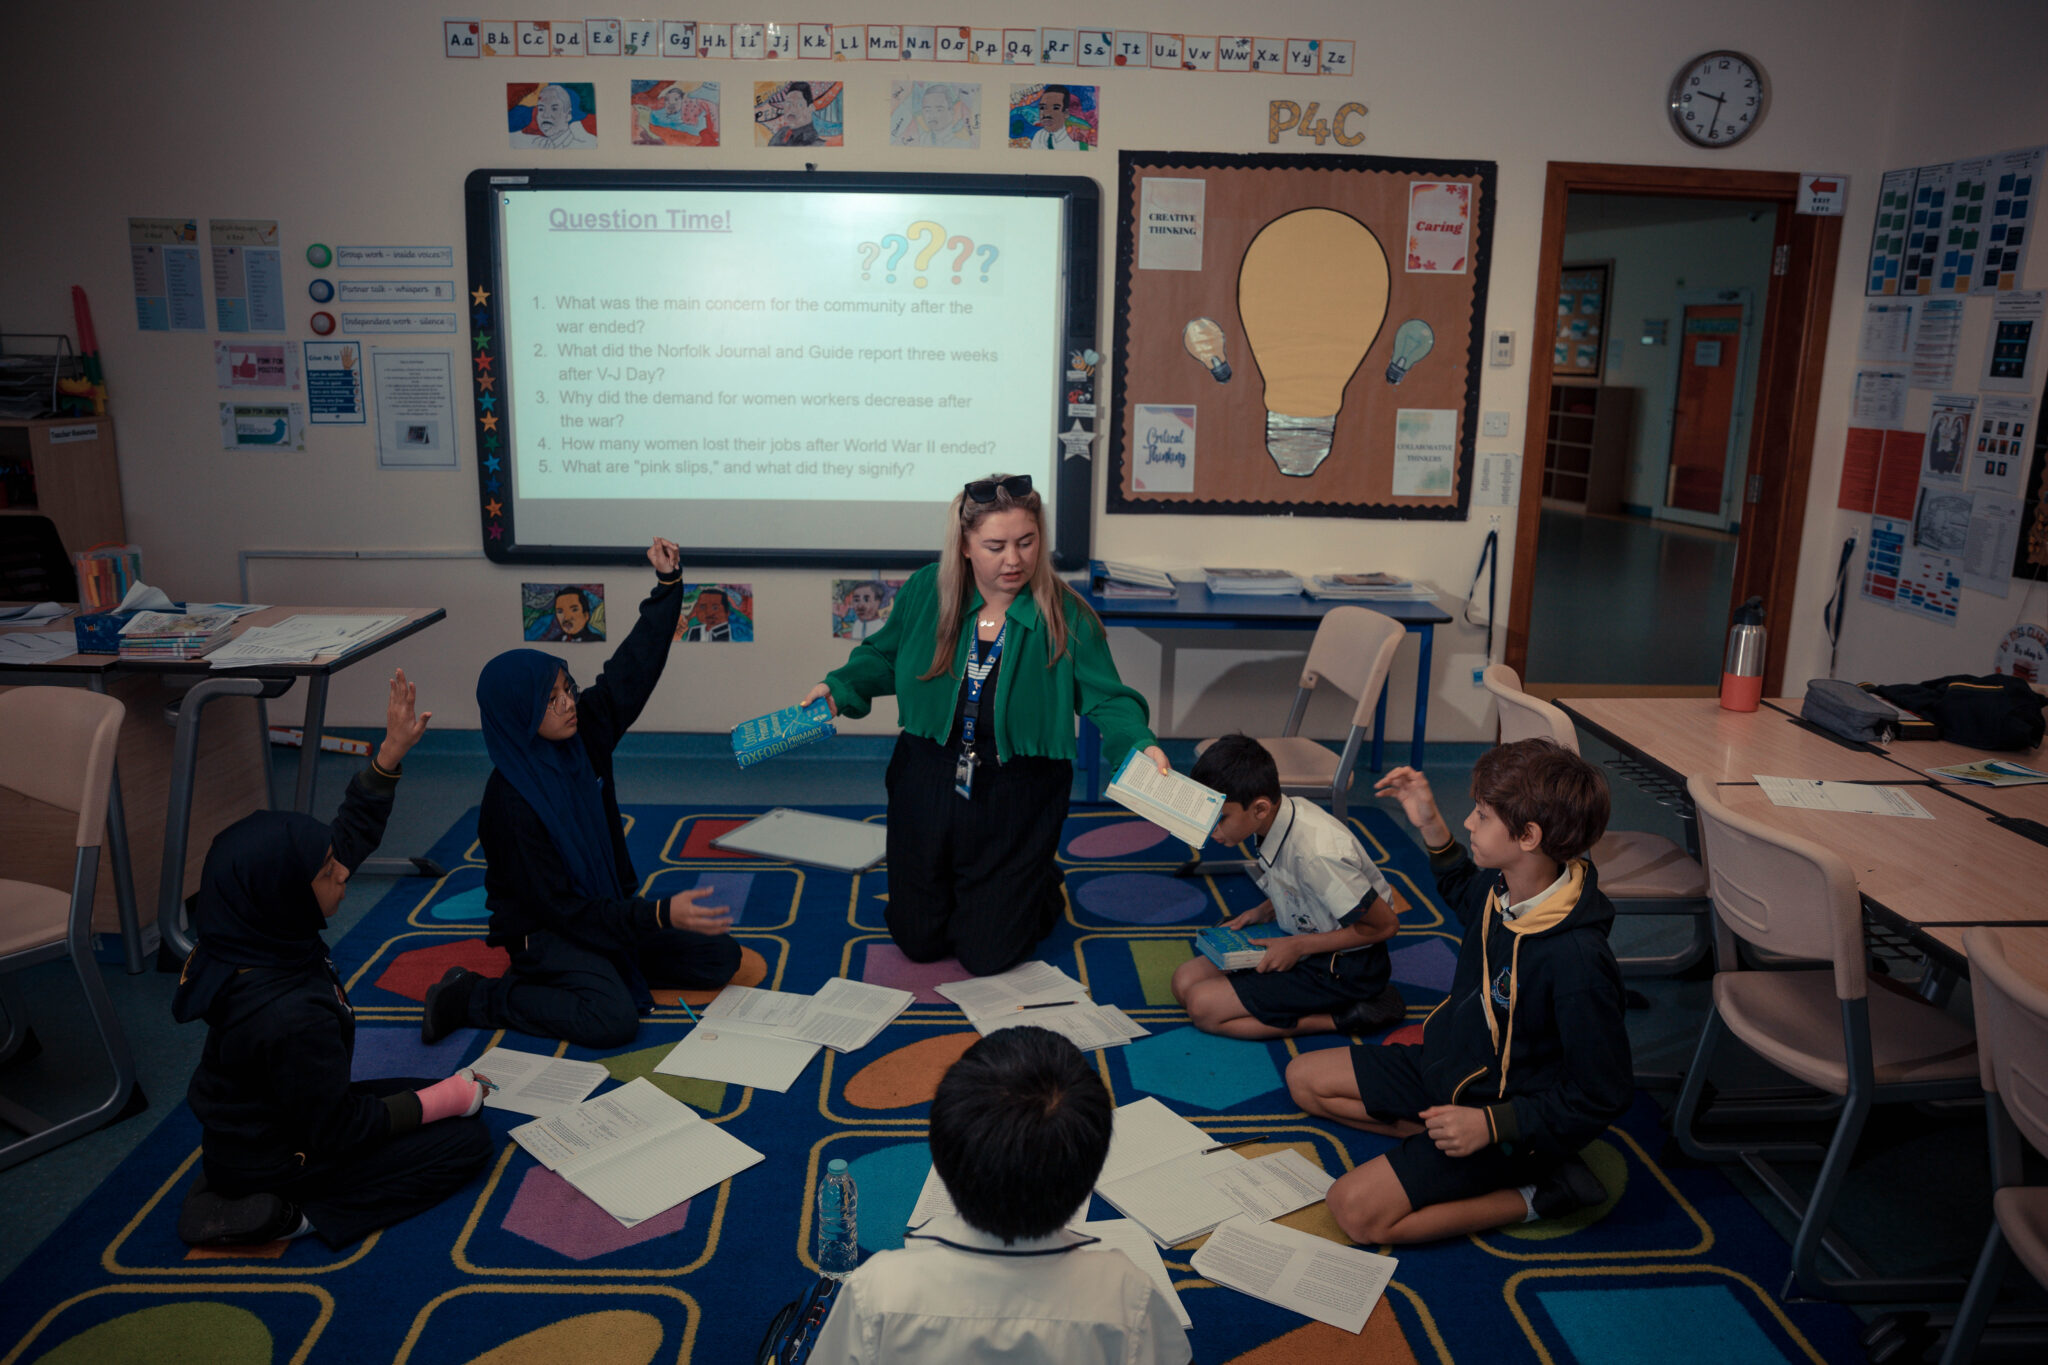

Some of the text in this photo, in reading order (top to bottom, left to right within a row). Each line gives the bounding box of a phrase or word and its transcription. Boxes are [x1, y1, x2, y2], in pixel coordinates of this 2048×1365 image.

[1718, 60, 1730, 70] 12
[1703, 66, 1711, 75] 11
[1690, 76, 1700, 86] 10
[1744, 79, 1753, 88] 2
[1682, 93, 1692, 102] 9
[1746, 96, 1755, 106] 3
[1685, 111, 1695, 121] 8
[1739, 113, 1748, 122] 4
[1268, 99, 1368, 147] P4C
[1696, 124, 1704, 134] 7
[1726, 126, 1735, 135] 5
[549, 208, 732, 230] Question Time!
[1149, 213, 1197, 222] CREATIVE
[1148, 226, 1197, 235] THINKING
[1416, 221, 1465, 235] Caring
[340, 250, 363, 260] Group
[395, 285, 429, 294] whispers
[532, 296, 973, 316] 1. What was the main concern for the community after the
[345, 318, 391, 327] Independent
[557, 320, 646, 334] war ended?
[533, 344, 998, 363] 2. What did the Norfolk Journal and Guide report three weeks
[559, 367, 665, 384] after V-J Day?
[535, 391, 972, 408] 3. Why did the demand for women workers decrease after
[560, 414, 624, 428] the war?
[537, 437, 996, 455] 4. How many women lost their jobs after World War II ended?
[538, 460, 552, 474] 5.
[562, 460, 602, 474] What
[606, 463, 629, 474] are
[723, 461, 751, 474] and
[756, 461, 790, 475] what
[795, 461, 818, 475] did
[822, 461, 852, 477] they
[858, 462, 915, 479] signify?
[787, 727, 822, 745] PRIMARY
[741, 740, 789, 766] OXFORD
